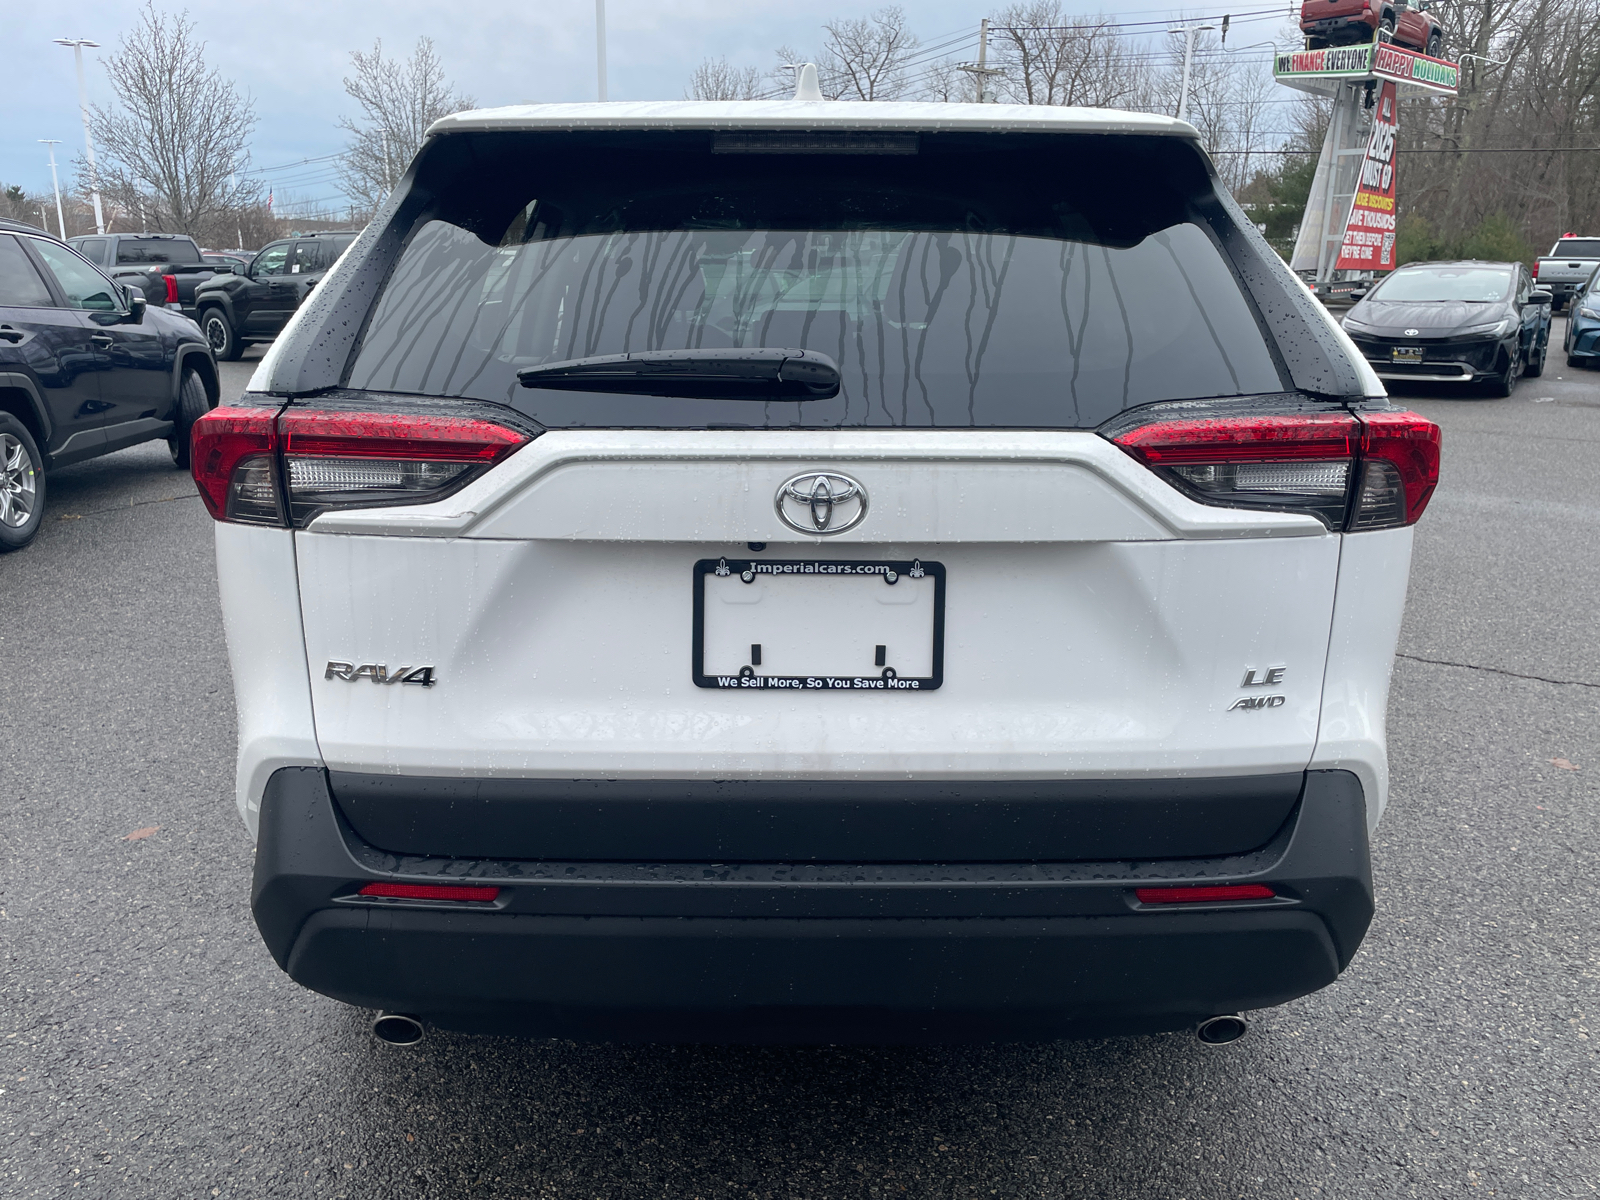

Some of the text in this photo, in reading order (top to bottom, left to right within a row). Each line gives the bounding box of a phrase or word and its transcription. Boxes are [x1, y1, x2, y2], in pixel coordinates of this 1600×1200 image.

[1278, 48, 1369, 73] WE FINANCE EVERYONE
[1375, 47, 1457, 88] HAPPY HOLIDAYS
[1382, 97, 1392, 118] ALL
[1369, 118, 1400, 163] 2025
[1362, 159, 1392, 190] MUST GO
[1349, 209, 1396, 231] AVE THOUSANDS
[750, 562, 890, 575] Imperialcars.com
[324, 659, 438, 689] RAV4
[717, 677, 919, 689] We Sell More, So You Save More
[1240, 665, 1287, 688] LE
[1227, 694, 1286, 712] AWD
